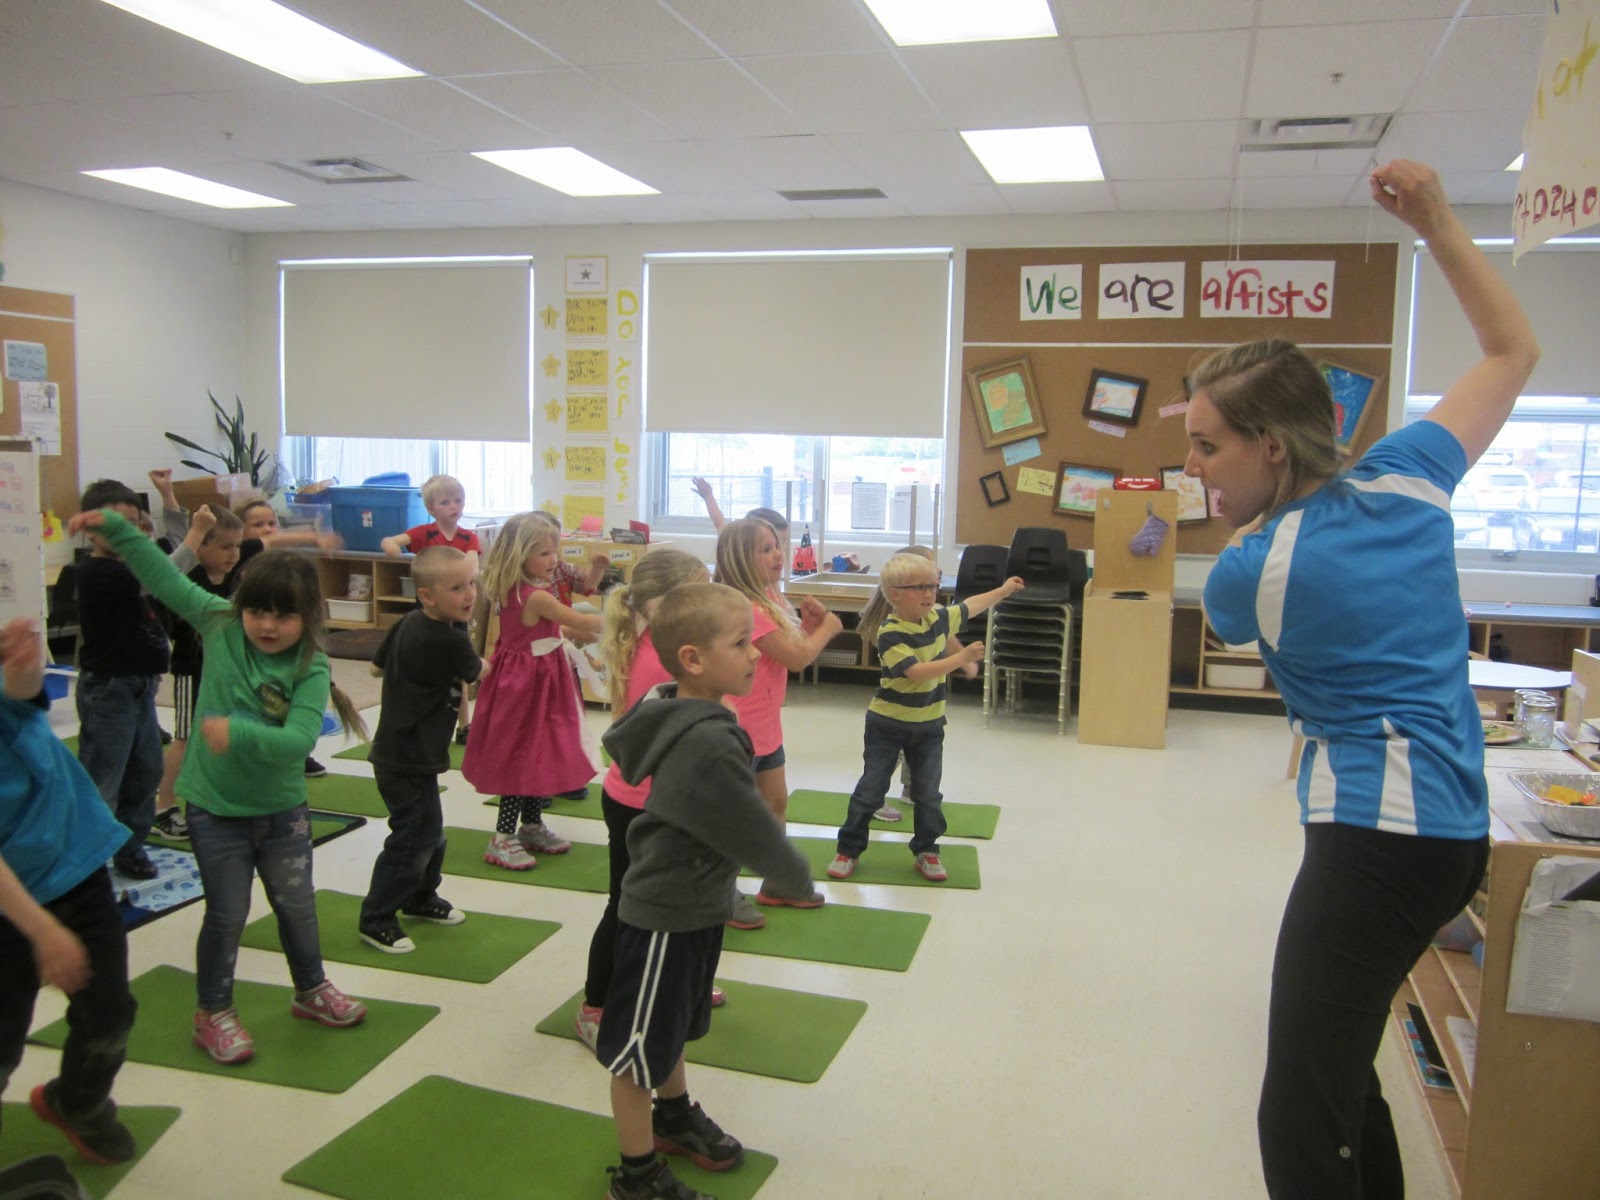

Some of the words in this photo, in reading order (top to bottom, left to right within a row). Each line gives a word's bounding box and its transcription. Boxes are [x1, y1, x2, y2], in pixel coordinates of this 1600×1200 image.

[1026, 273, 1081, 315] We
[1104, 274, 1175, 314] are
[1202, 268, 1328, 318] artists
